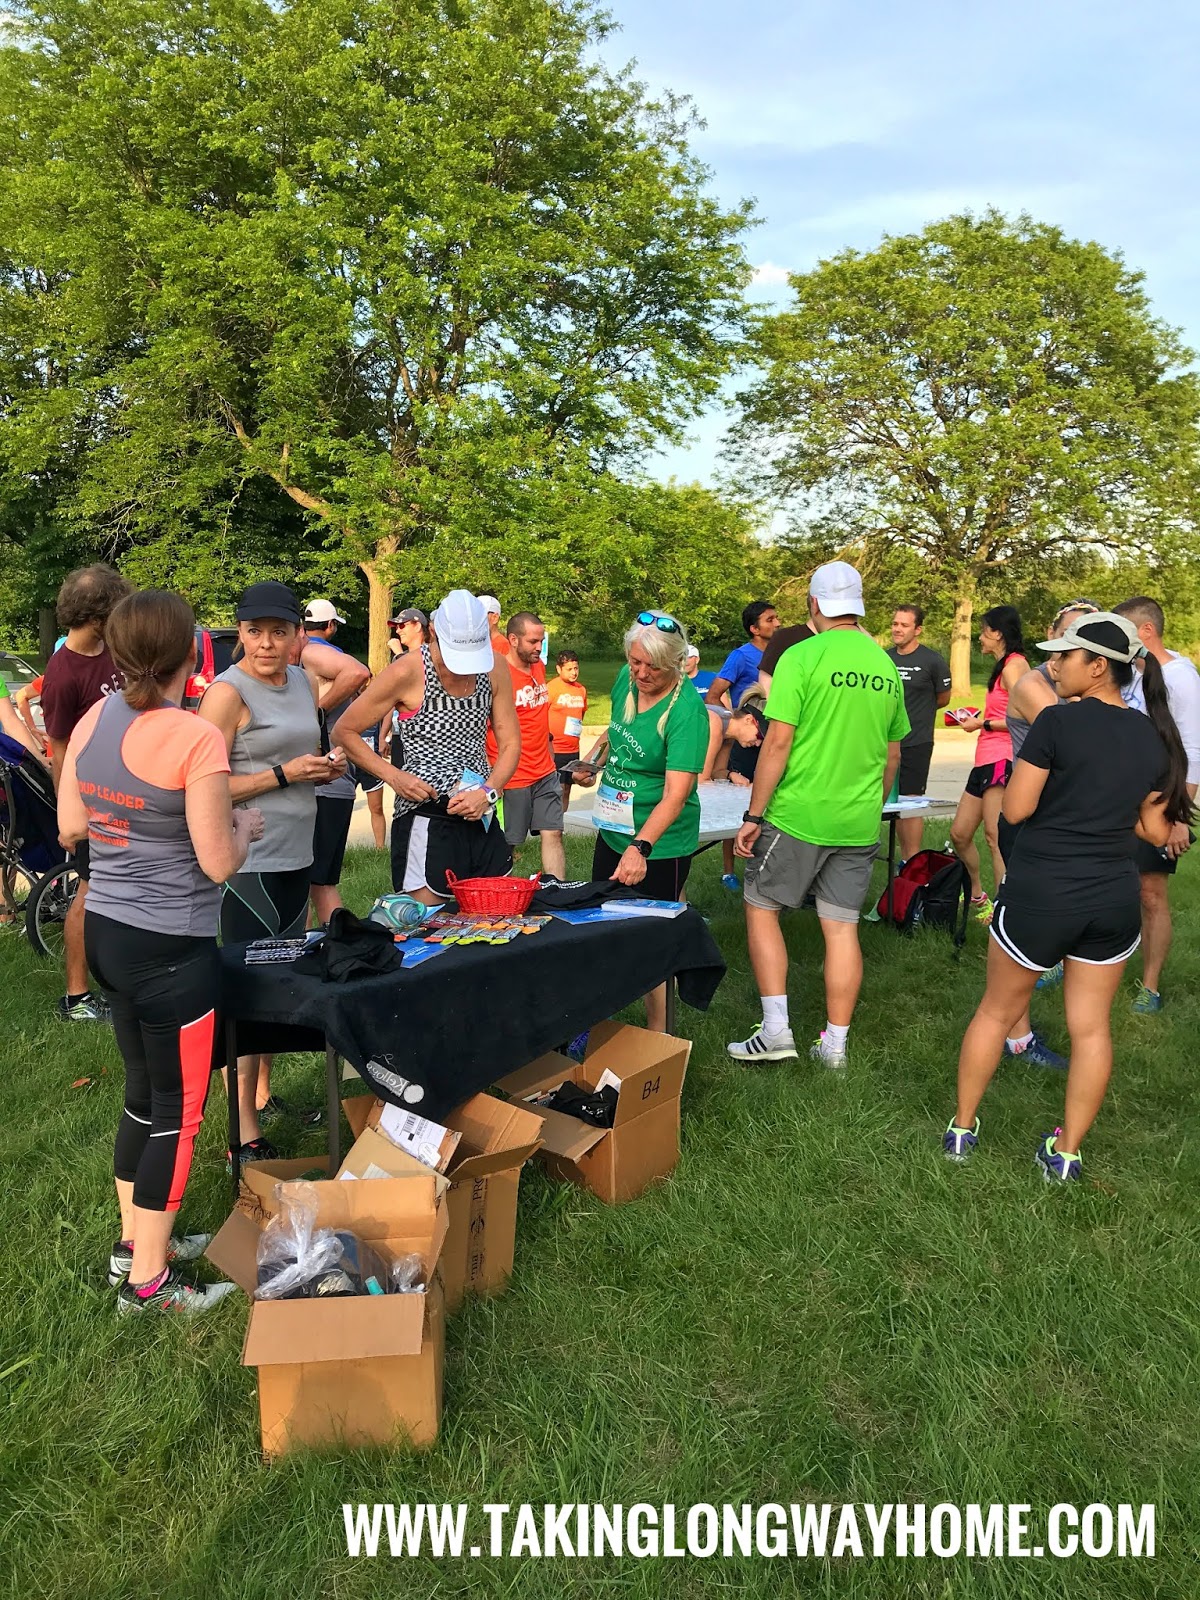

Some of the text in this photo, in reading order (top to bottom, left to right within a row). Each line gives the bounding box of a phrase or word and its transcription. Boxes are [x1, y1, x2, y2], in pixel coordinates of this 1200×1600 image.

[622, 728, 646, 758] WOODS
[616, 778, 637, 788] CLUB
[97, 784, 145, 810] LEADER
[642, 1075, 661, 1101] B4
